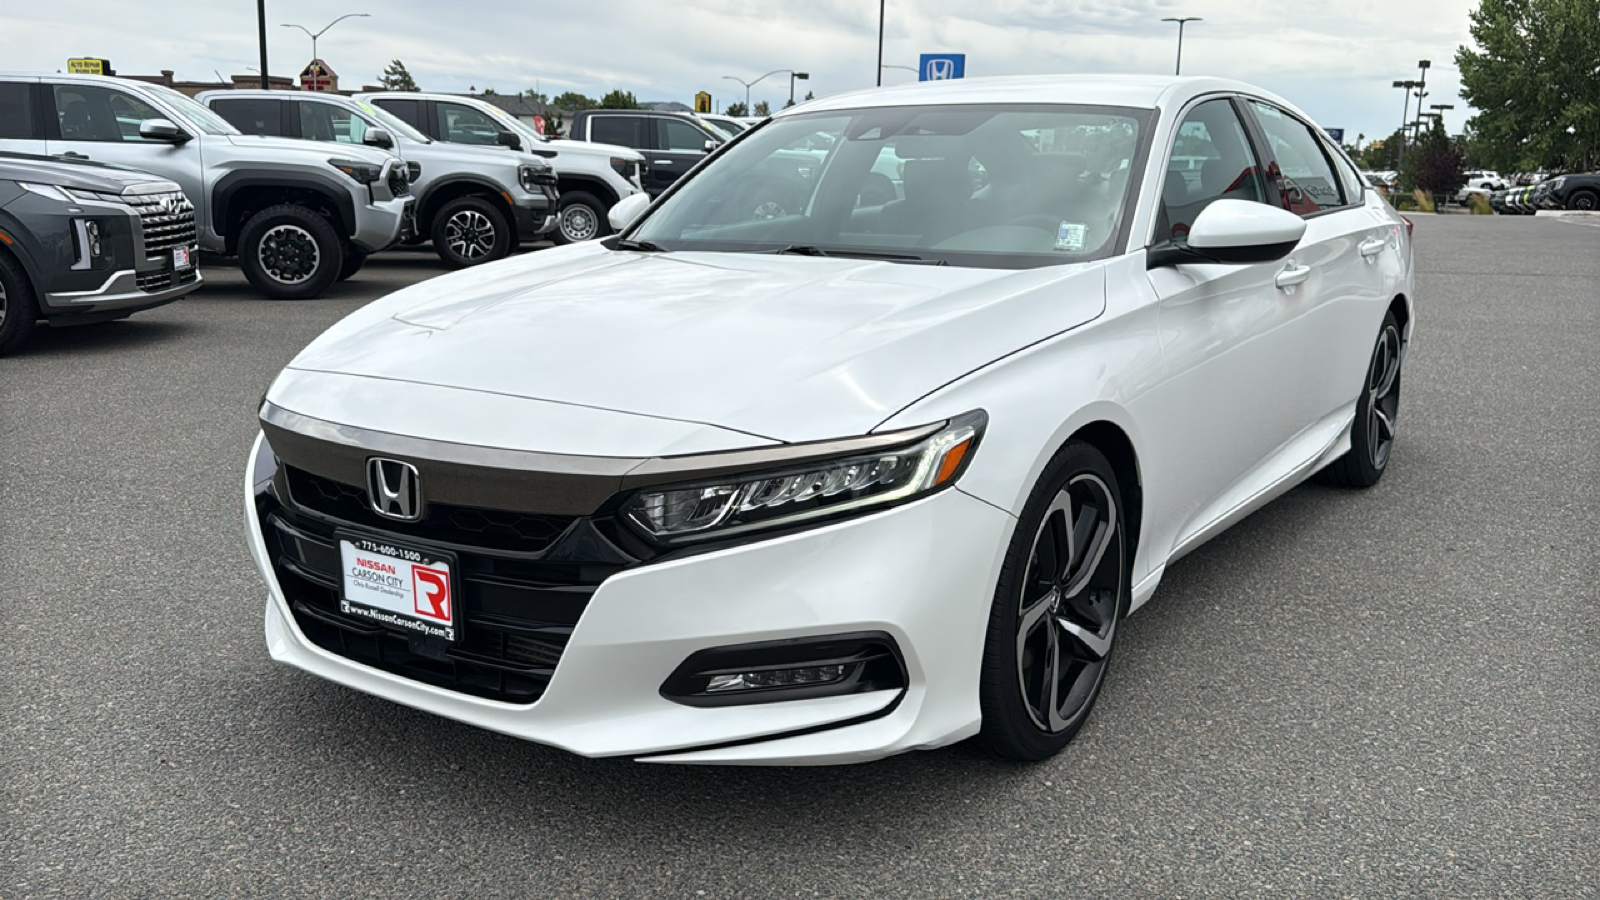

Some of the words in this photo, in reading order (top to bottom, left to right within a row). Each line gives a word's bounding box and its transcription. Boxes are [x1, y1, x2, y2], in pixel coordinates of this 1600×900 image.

[361, 540, 421, 561] 775-600-1500
[356, 557, 396, 575] NISSAN
[352, 567, 385, 583] CARSON
[385, 576, 403, 588] CITY
[415, 570, 447, 620] R
[350, 606, 445, 635] www.NissanCarsonCity.com
